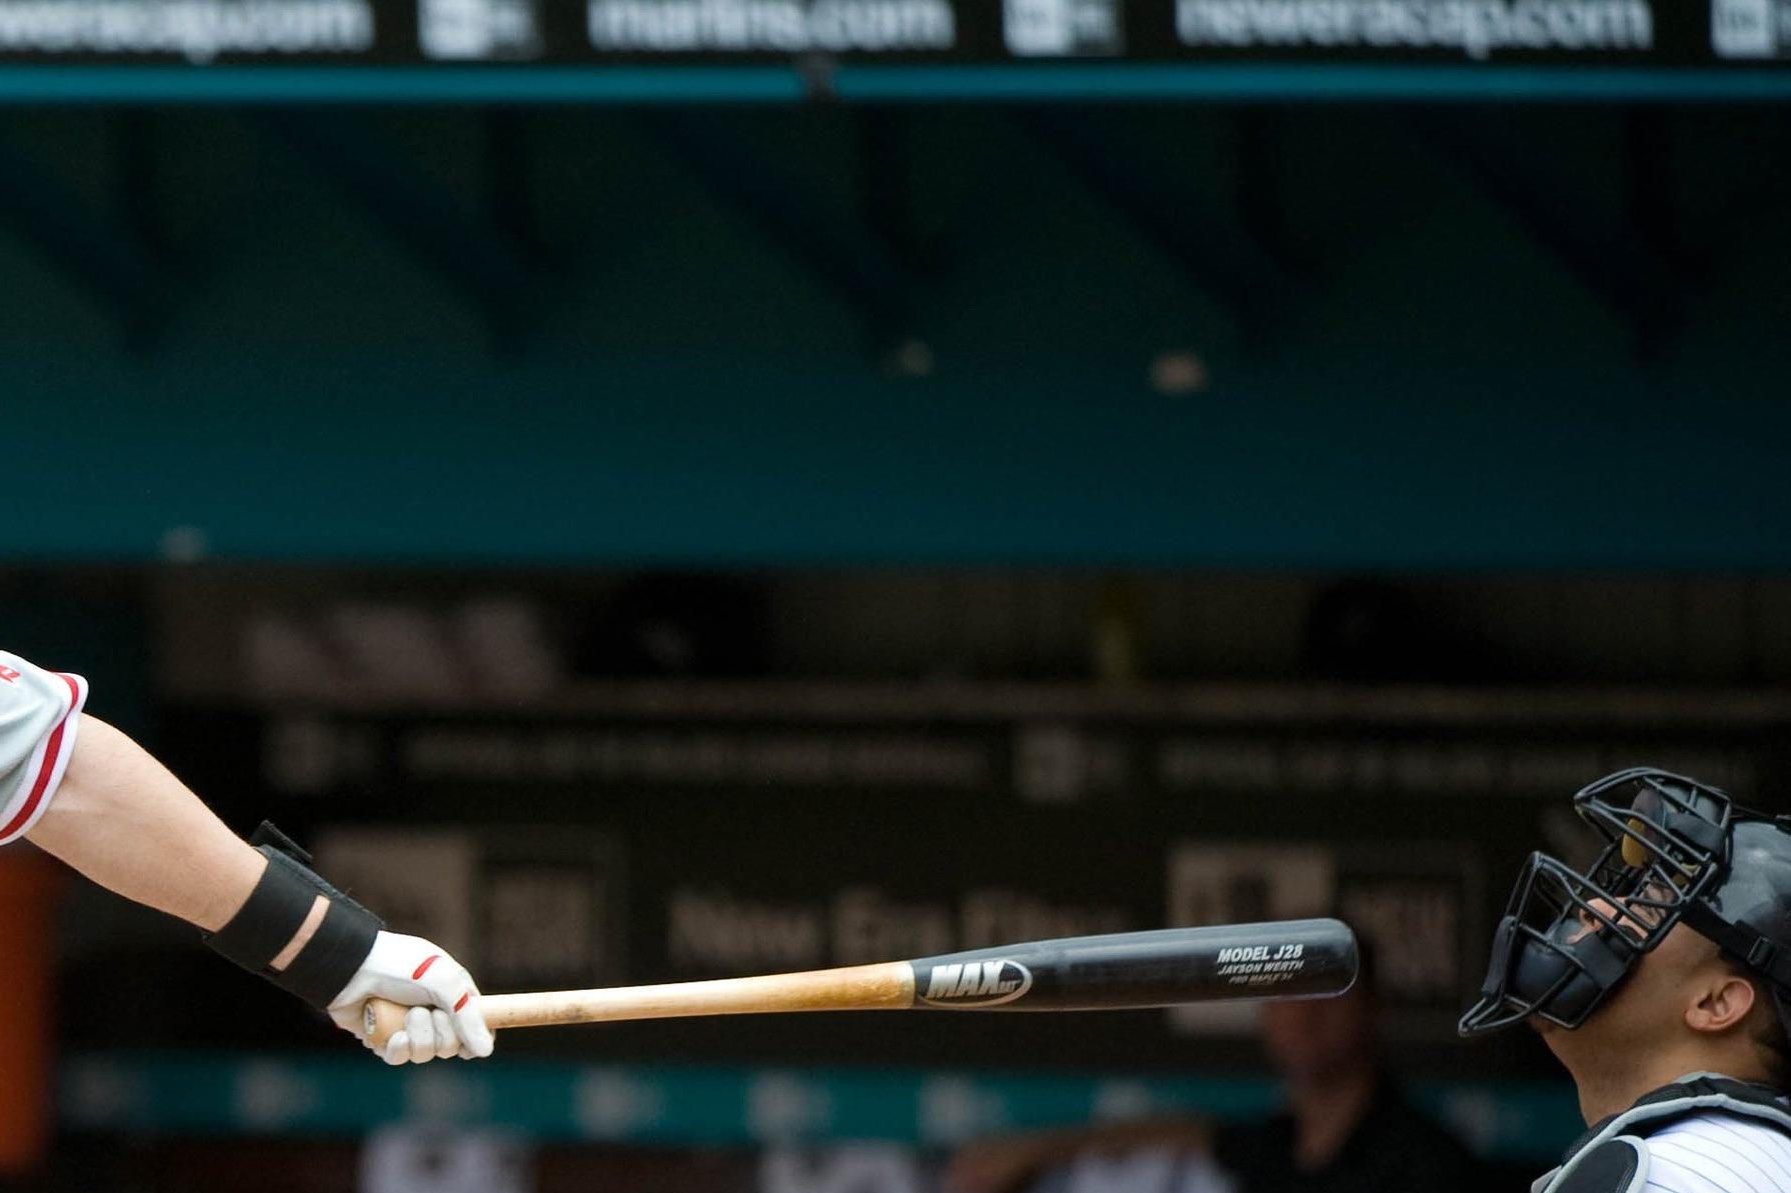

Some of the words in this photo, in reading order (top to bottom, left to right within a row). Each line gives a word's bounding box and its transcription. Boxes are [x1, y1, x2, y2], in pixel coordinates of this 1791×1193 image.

[1607, 352, 1667, 427] F
[1217, 945, 1270, 963] MODEL
[1273, 943, 1304, 960] J28
[926, 961, 1006, 998] MAX
[1217, 962, 1263, 976] JAYSON
[1263, 959, 1306, 972] WERTH
